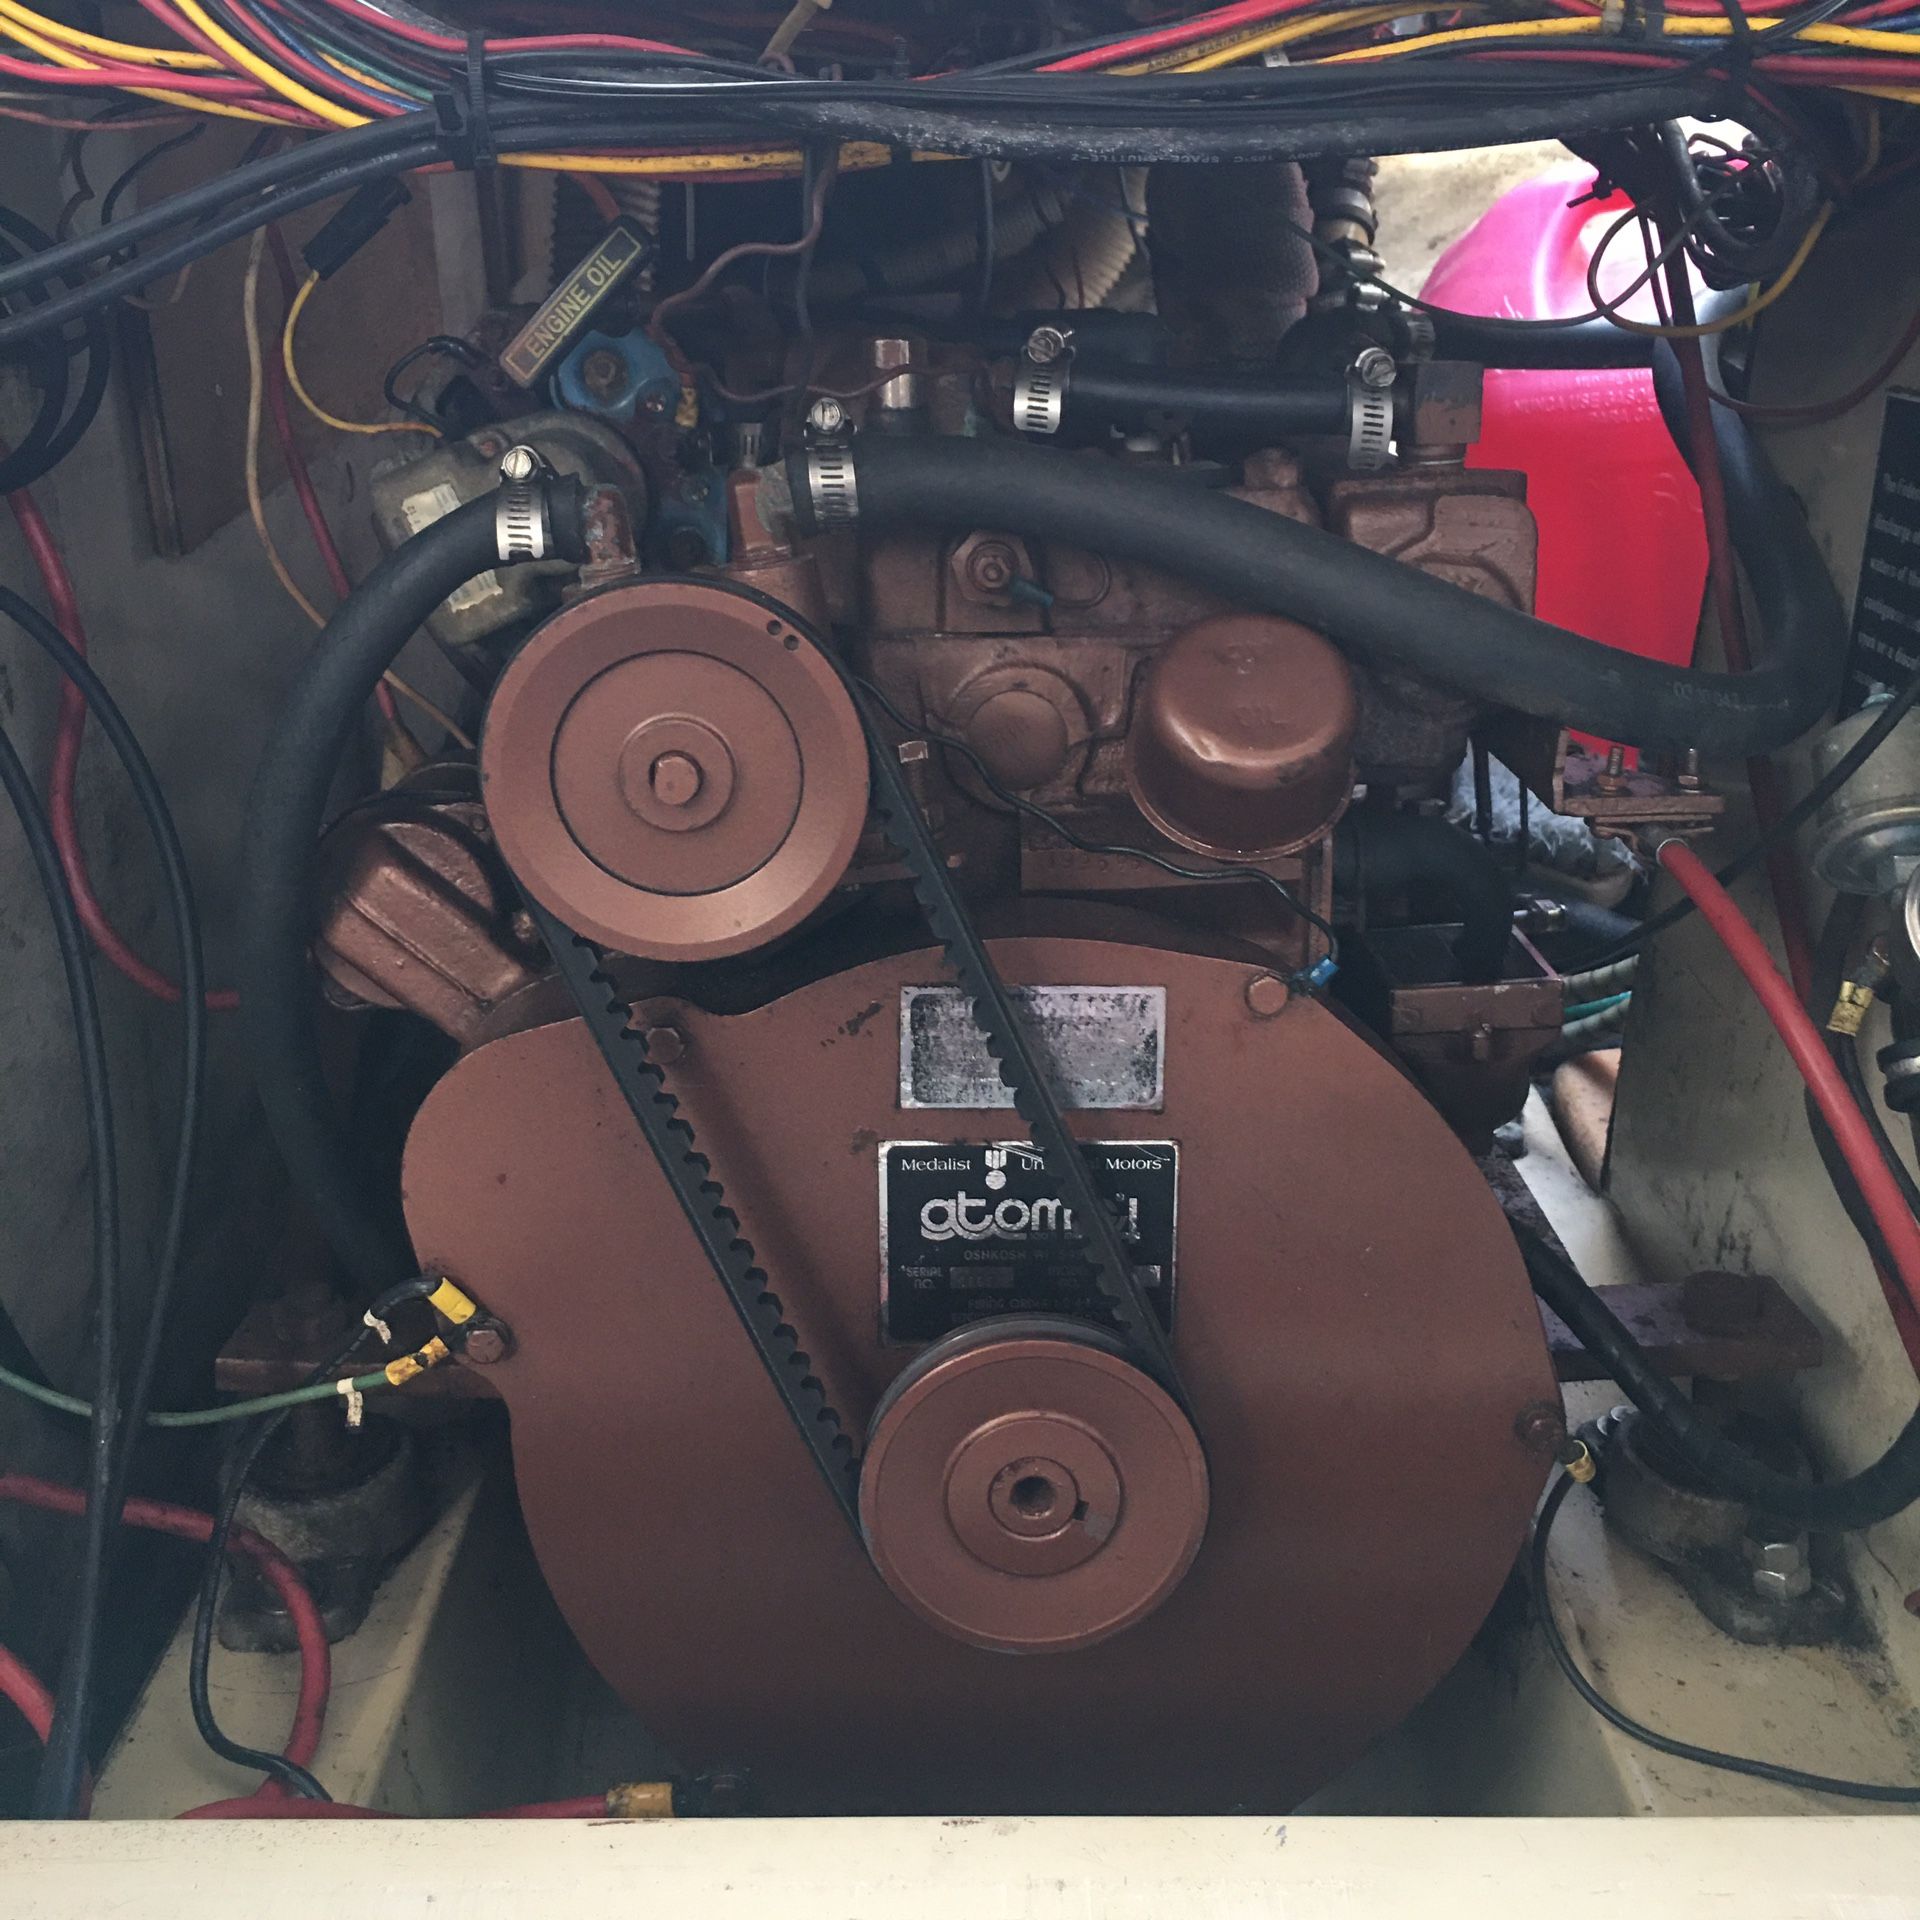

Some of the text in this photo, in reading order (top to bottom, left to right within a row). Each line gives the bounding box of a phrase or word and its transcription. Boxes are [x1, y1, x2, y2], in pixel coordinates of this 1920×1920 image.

[524, 254, 622, 359] ENGINE OIL
[901, 1156, 1162, 1172] Medalist Motors
